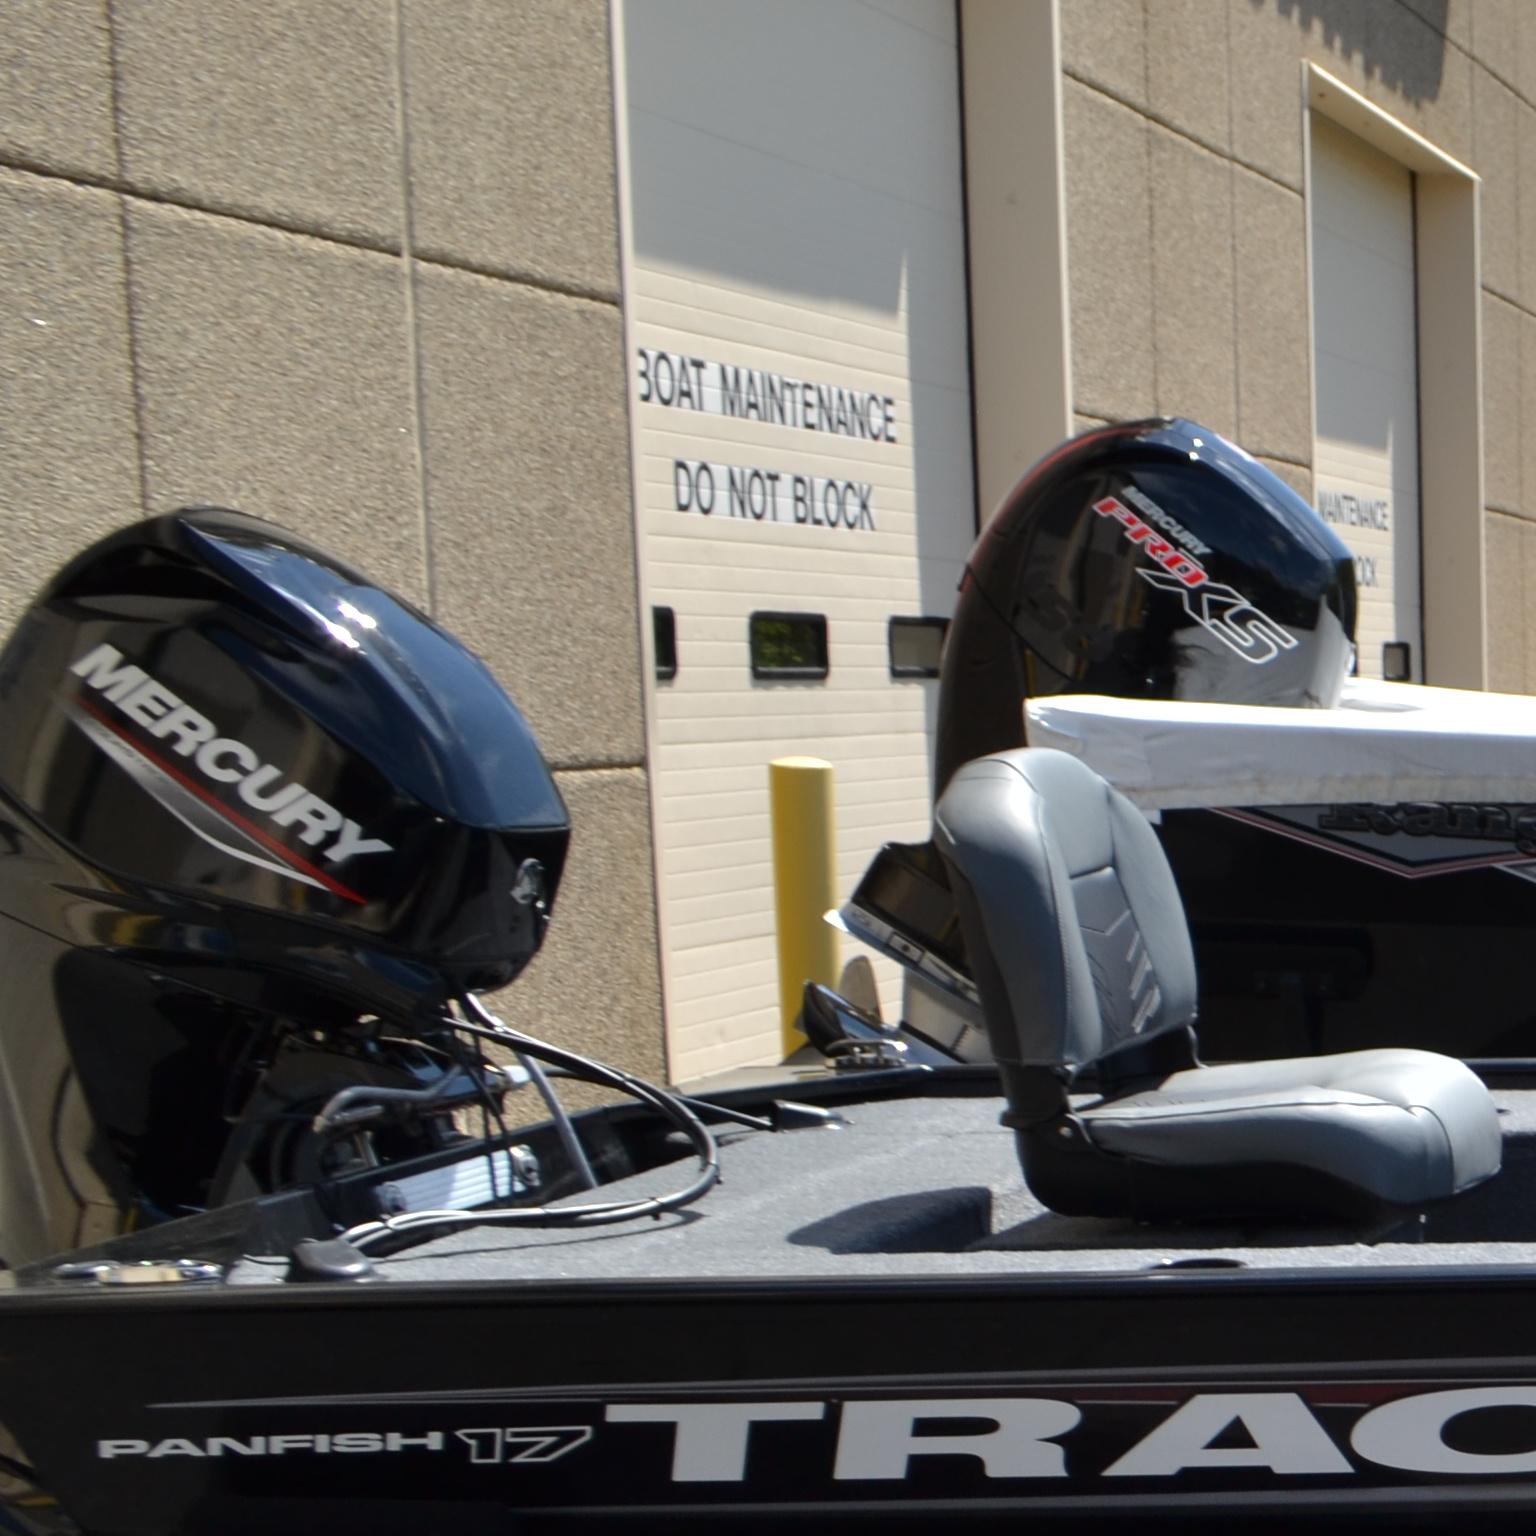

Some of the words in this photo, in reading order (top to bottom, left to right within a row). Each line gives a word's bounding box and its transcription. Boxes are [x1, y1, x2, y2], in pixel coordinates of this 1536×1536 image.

[638, 348, 705, 411] BOAT
[719, 364, 896, 443] MAINTENANCE
[675, 461, 715, 515] DO
[728, 466, 779, 521] NOT
[793, 476, 875, 530] BLOCK
[1121, 485, 1213, 555] MERCURY
[1092, 496, 1208, 588] PRO
[1134, 565, 1298, 664] XS
[70, 643, 394, 863] MERCURY
[98, 1432, 443, 1459] PANFISH
[455, 1425, 592, 1463] 17
